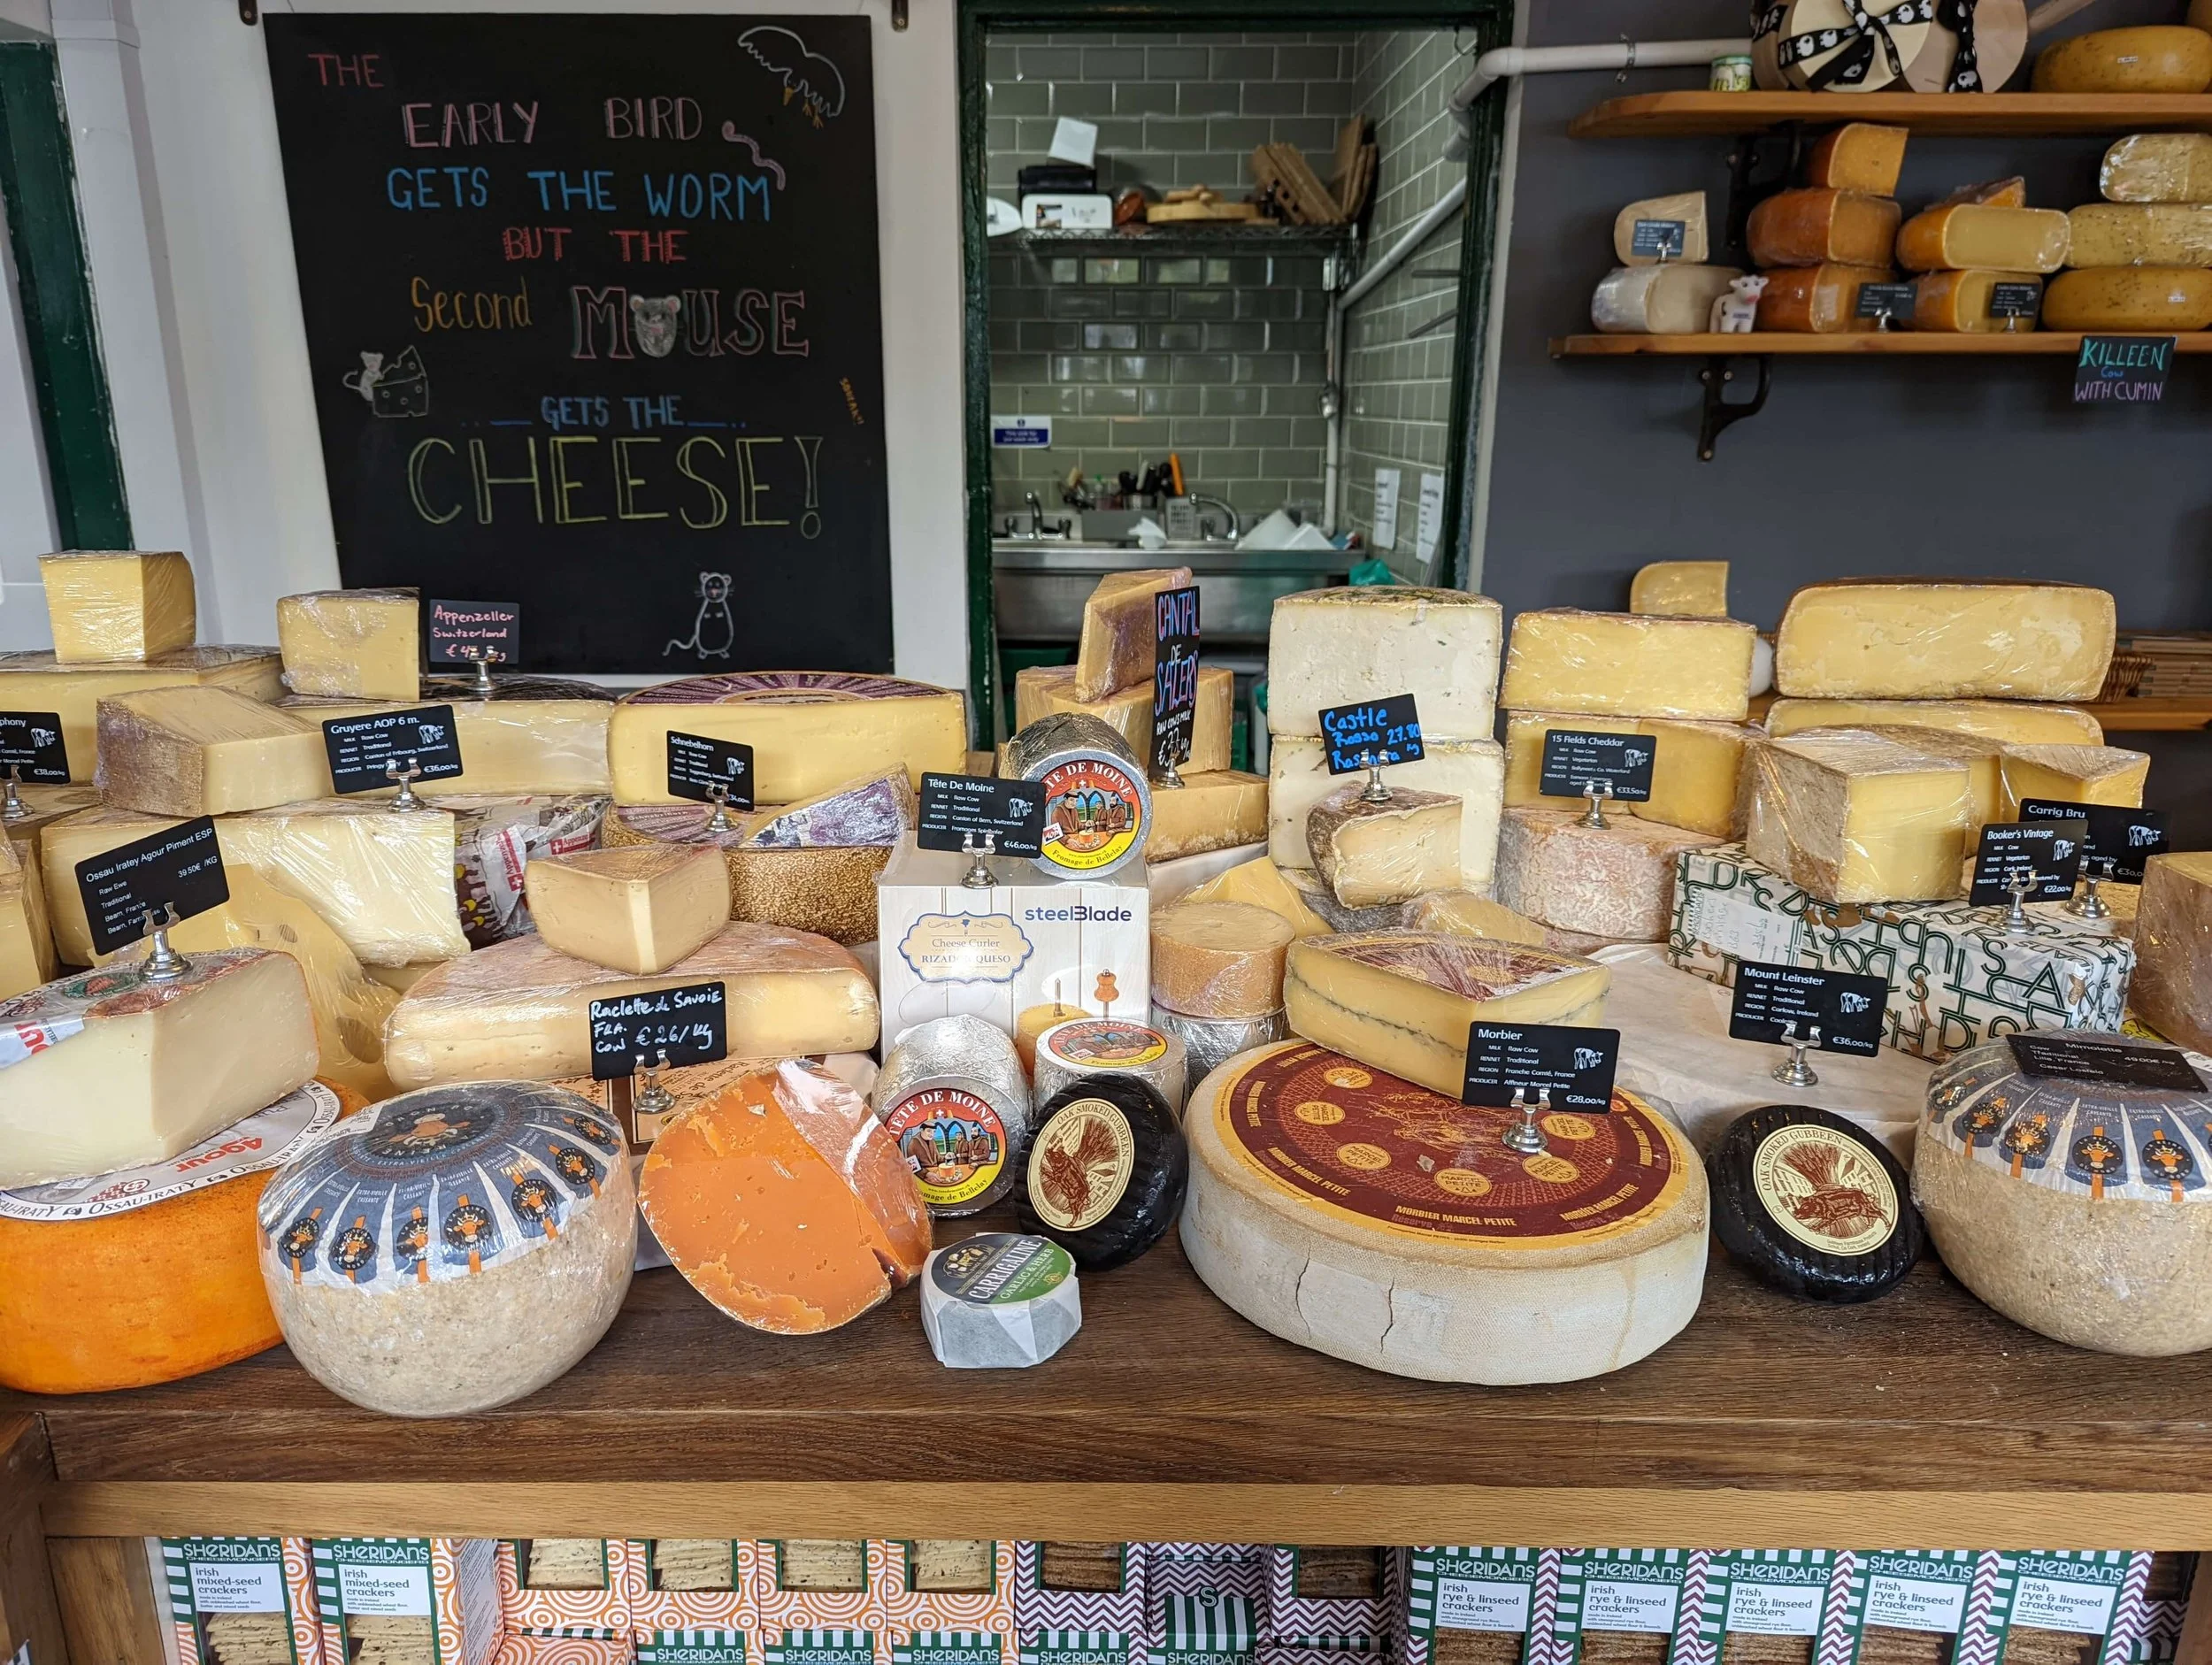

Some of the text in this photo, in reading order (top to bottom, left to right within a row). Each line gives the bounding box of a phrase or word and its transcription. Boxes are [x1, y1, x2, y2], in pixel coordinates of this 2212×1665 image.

[308, 53, 385, 87] THE
[403, 97, 703, 147] EARLY BIRD
[388, 167, 771, 221] GETS THE WORM
[503, 226, 689, 262] BUT THE
[411, 275, 533, 332] Second
[2078, 338, 2168, 371] KILLEEN
[2101, 366, 2124, 379] Cow
[2075, 381, 2162, 402] WITH CUMIN
[541, 395, 686, 433] GETS THE
[408, 436, 823, 539] CHEESE!
[434, 604, 514, 625] Appenzeller
[1158, 590, 1200, 641] CANTAL
[433, 627, 507, 638] Switzerland
[1171, 644, 1182, 664] DE
[1155, 650, 1200, 717] SALERS
[331, 723, 372, 734] Gruyere
[374, 718, 396, 728] AOP
[1325, 708, 1387, 732] Castle
[671, 736, 714, 751] Schnebelhorn
[1564, 735, 1586, 744] Fields
[1588, 737, 1624, 747] Cheddar
[928, 779, 995, 793] Tête De Moine
[1066, 762, 1133, 797] DE MOINE
[2028, 805, 2085, 818] Carrig Bru
[1987, 829, 2054, 840] Booker's Vintage
[86, 827, 212, 882] Ossau Iratey Agour Piment ESP
[1052, 850, 1083, 865] Fromage
[1096, 845, 1123, 863] Bellelay
[99, 880, 127, 895] Raw Ewe
[101, 893, 132, 909] Traditional
[932, 938, 1000, 948] Cheese Curler
[1745, 968, 1825, 986] Mount Leinster
[591, 997, 654, 1020] Raclette
[1772, 996, 1805, 1005] Traditional
[1479, 1029, 1523, 1040] Morbier
[2065, 1042, 2123, 1054] Mimolette
[888, 1091, 997, 1137] TÊTE DE MOINE
[1057, 1103, 1130, 1157] OAK SMOKED GUBBEEN
[1759, 1130, 1844, 1191] OAK SMOKED GUBBEEN
[1395, 1205, 1517, 1226] MORBIER MARCEL PETITE
[968, 1239, 1042, 1300] CARRIGALINE
[1000, 1270, 1031, 1299] GARLIC
[1034, 1248, 1054, 1269] HERB
[183, 1543, 280, 1558] SHERIDANS
[334, 1545, 429, 1561] SHERIDANS
[196, 1567, 219, 1577] irish
[344, 1569, 367, 1578] irish
[1436, 1558, 1535, 1578] SHERIDANS
[1585, 1561, 1684, 1580] SHERIDANS
[1731, 1562, 1832, 1581] SHERIDANS
[1870, 1555, 1974, 1579] SHERIDANS
[2018, 1557, 2125, 1581] SHERIDANS
[196, 1577, 262, 1585] mixed-seed
[346, 1578, 410, 1588] mixed-seed
[1443, 1583, 1468, 1592] irish
[2024, 1581, 2049, 1592] irish
[198, 1586, 248, 1595] crackers
[346, 1588, 395, 1597] crackers
[1442, 1602, 1494, 1613] crackers
[1479, 1594, 1519, 1605] linseed
[2019, 1600, 2073, 1613] crackers
[2021, 1592, 2103, 1607] rye & linseed
[657, 1648, 744, 1661] SHERIDANS
[786, 1649, 872, 1661] SHERIDANS
[912, 1649, 1000, 1662] SHERIDANS
[1041, 1651, 1126, 1663] SHERIDANS
[1167, 1652, 1253, 1665] SHERIDANS
